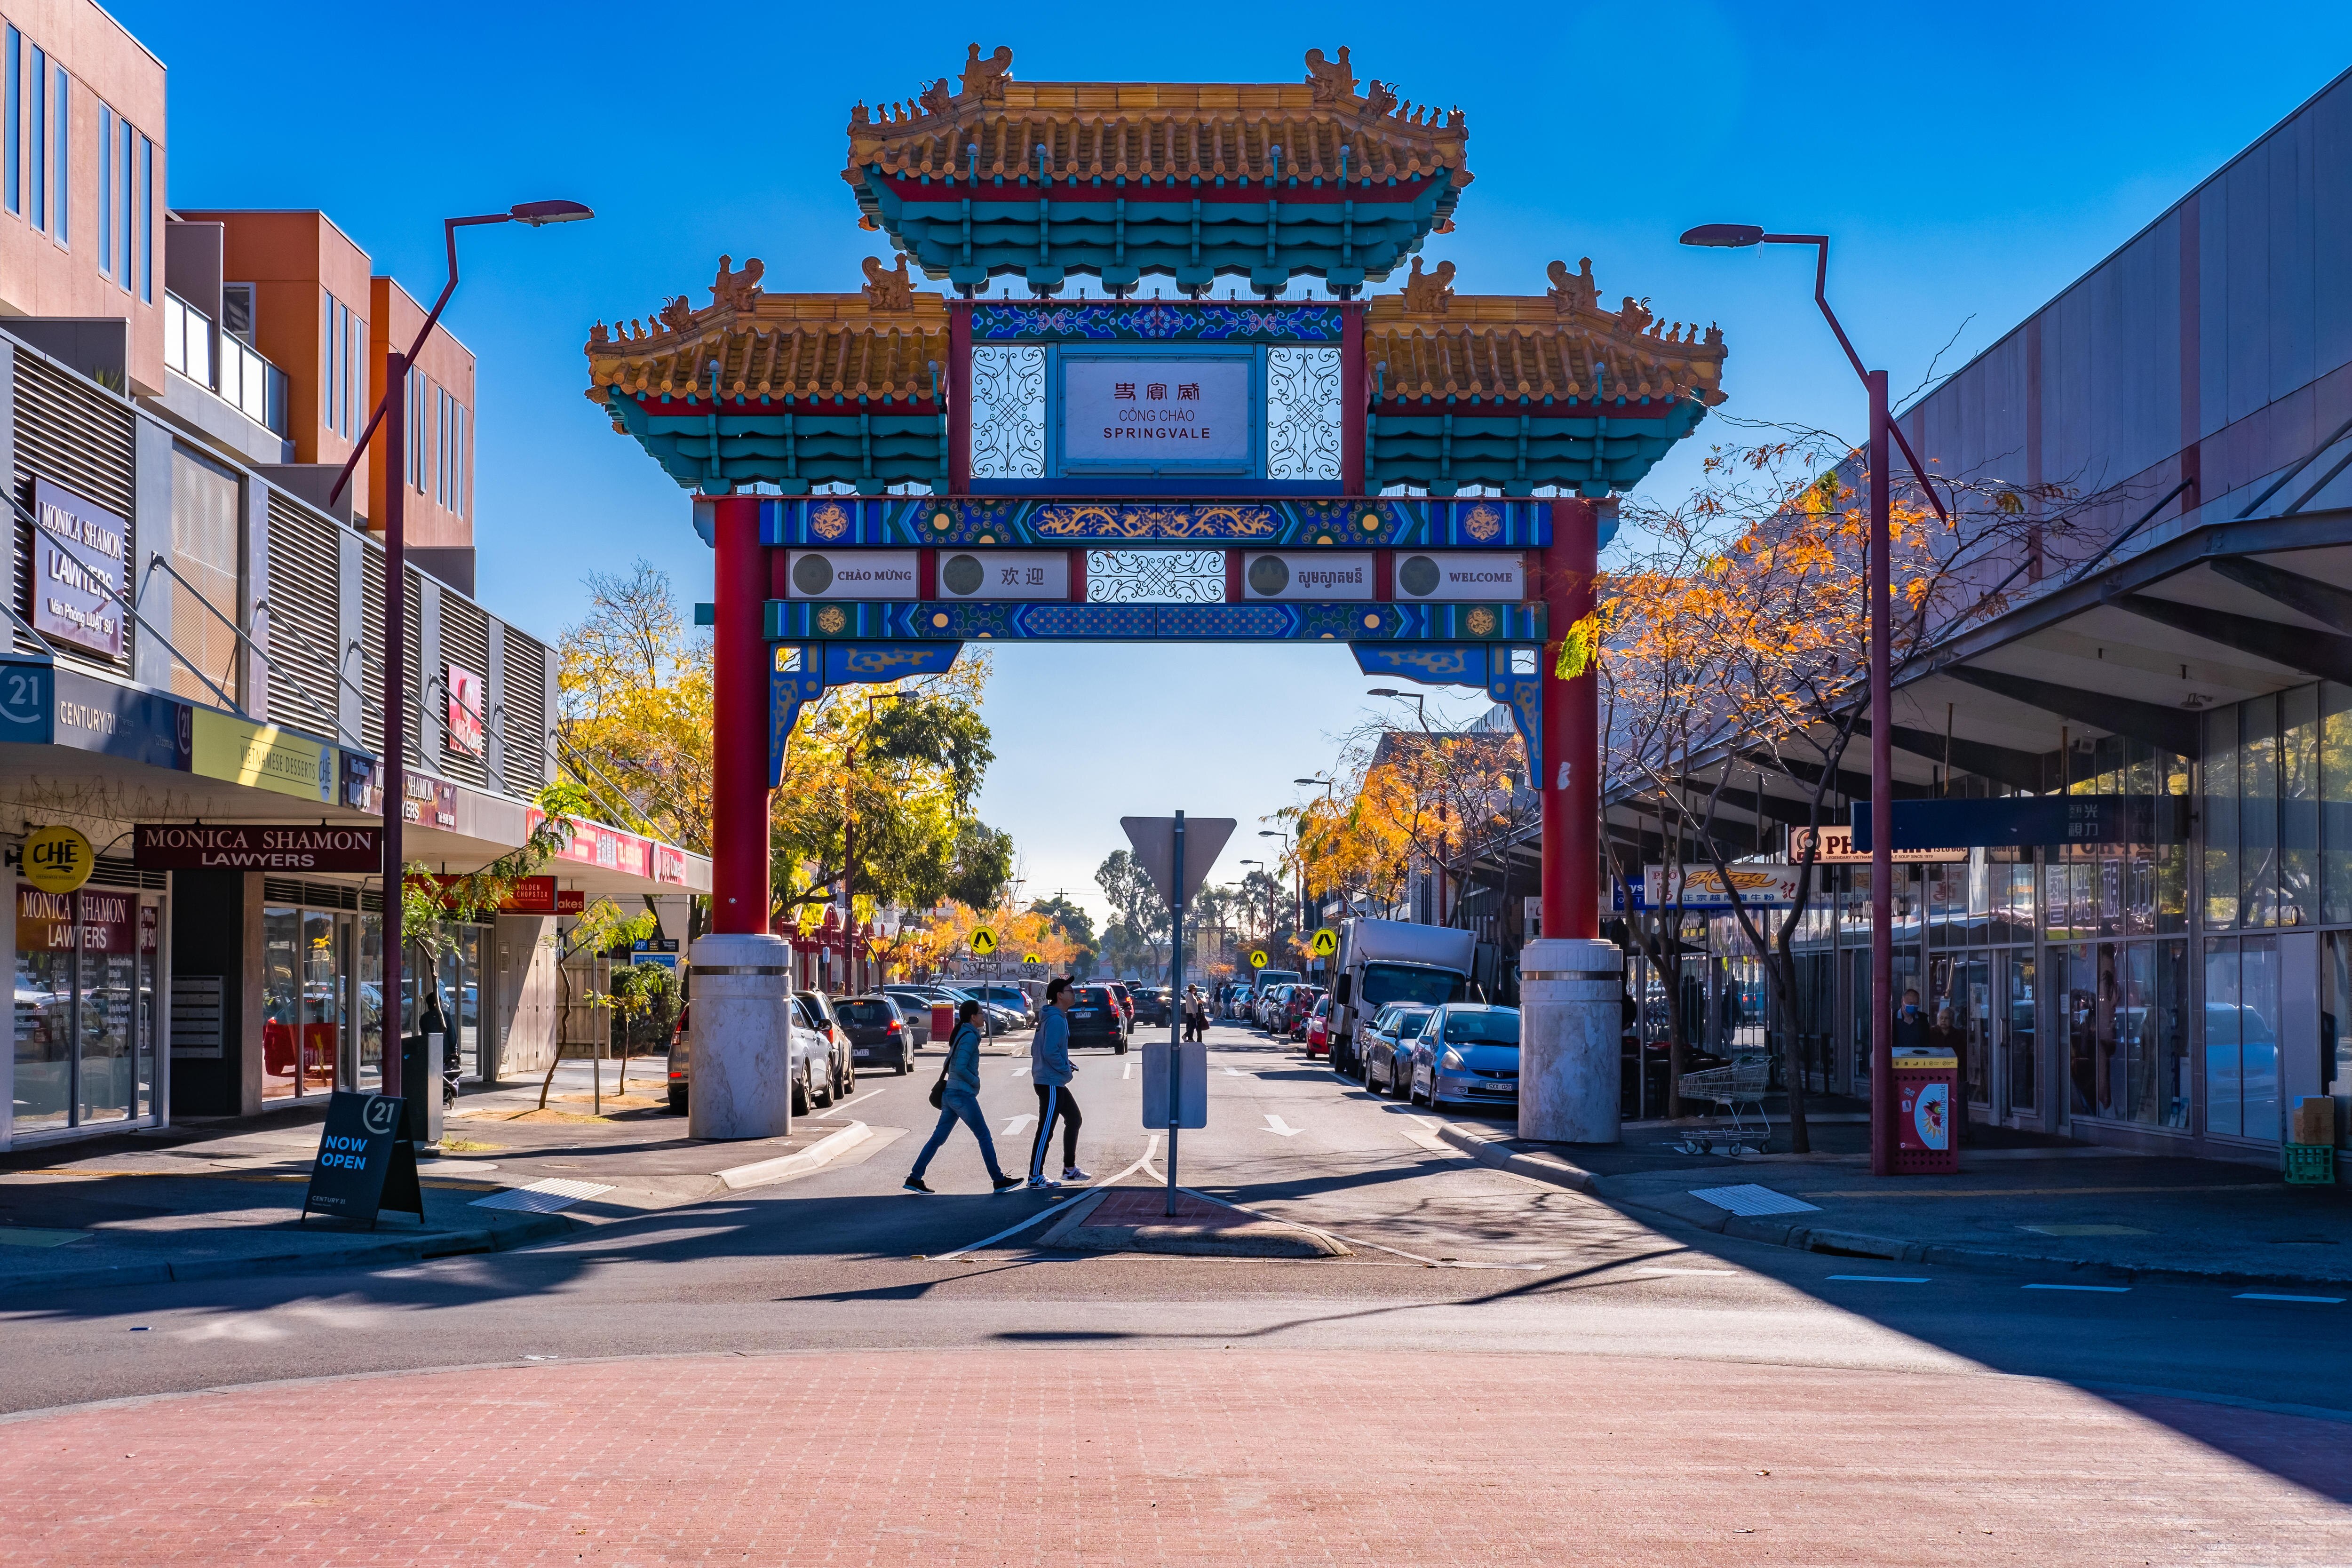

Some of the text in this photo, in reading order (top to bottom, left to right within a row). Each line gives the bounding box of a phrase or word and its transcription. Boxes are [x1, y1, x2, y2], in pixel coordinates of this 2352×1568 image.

[1119, 407, 1195, 422] CỔNG CHÀO
[1103, 427, 1210, 438] SPRINGVALE
[40, 501, 123, 560] MONICA SHAMON
[50, 549, 113, 601] LAWYERS
[837, 568, 912, 581] CHÀO MỪNG
[1001, 567, 1044, 585] 欢迎
[1449, 572, 1513, 582] WELCOME
[59, 701, 116, 735] CENTURY 21
[240, 744, 316, 780] VIETNAMESE DESSERTS
[406, 774, 434, 802] SHAMON
[145, 829, 373, 851] MONICA SHAMON
[202, 852, 315, 867] LAWYERS
[23, 891, 126, 924] MONICA SHAMON
[558, 897, 583, 909] akes
[48, 924, 107, 949] LAWYERS
[325, 1135, 368, 1152] NOW
[321, 1153, 366, 1170] OPEN
